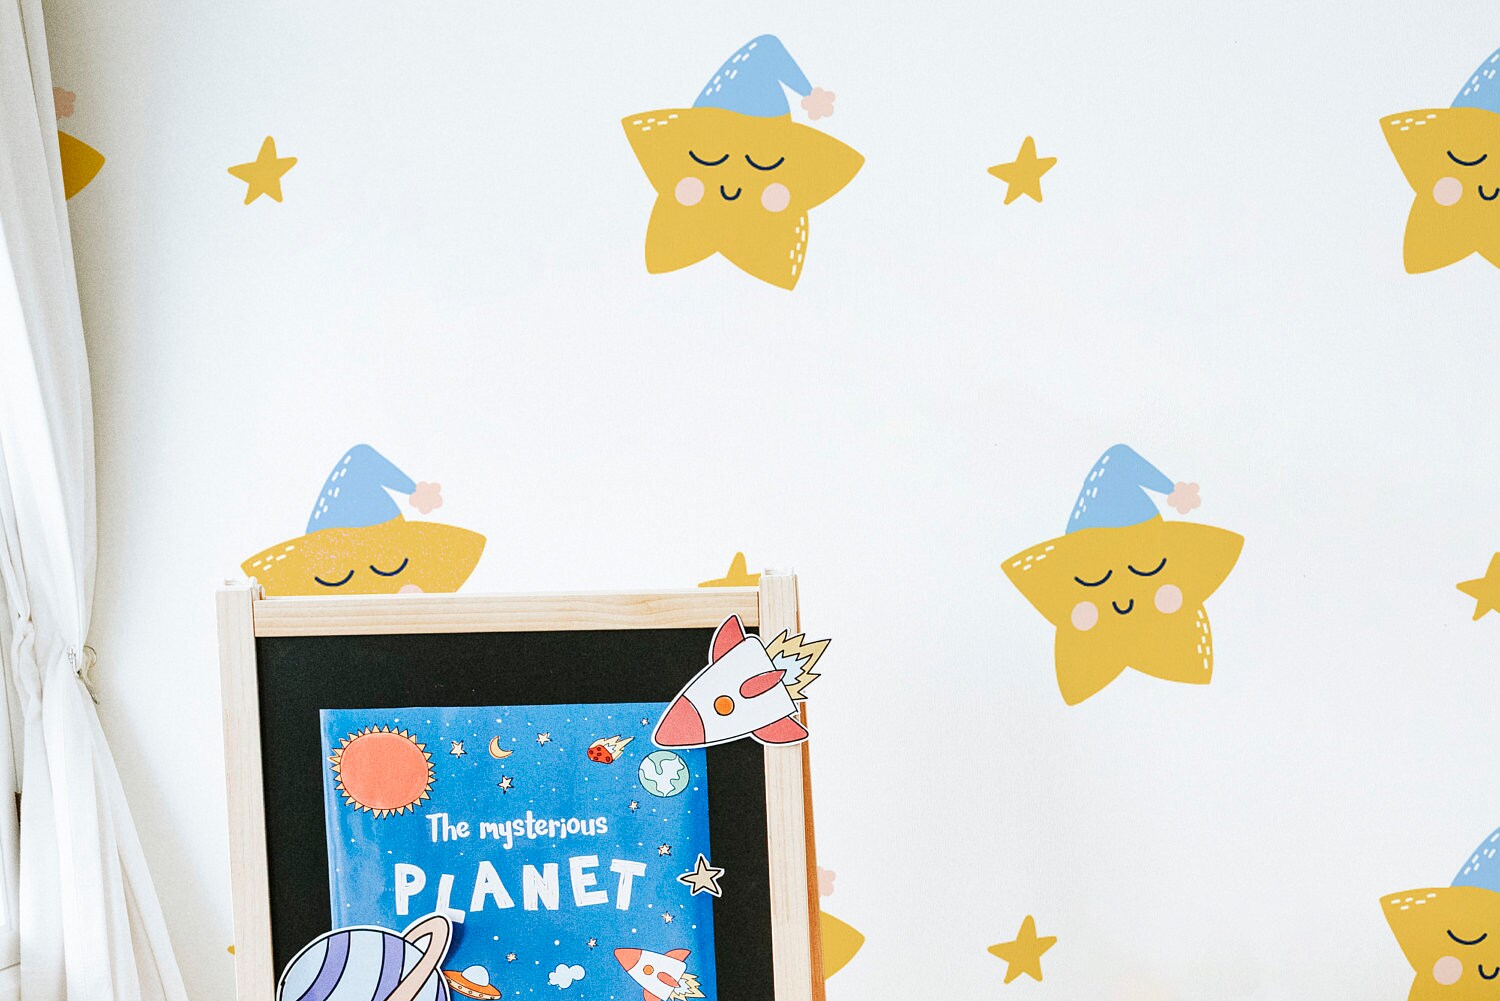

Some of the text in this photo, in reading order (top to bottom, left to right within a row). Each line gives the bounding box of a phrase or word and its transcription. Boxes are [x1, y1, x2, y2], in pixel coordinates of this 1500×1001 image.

[426, 810, 608, 850] The mysterious
[394, 855, 647, 924] PLANET
